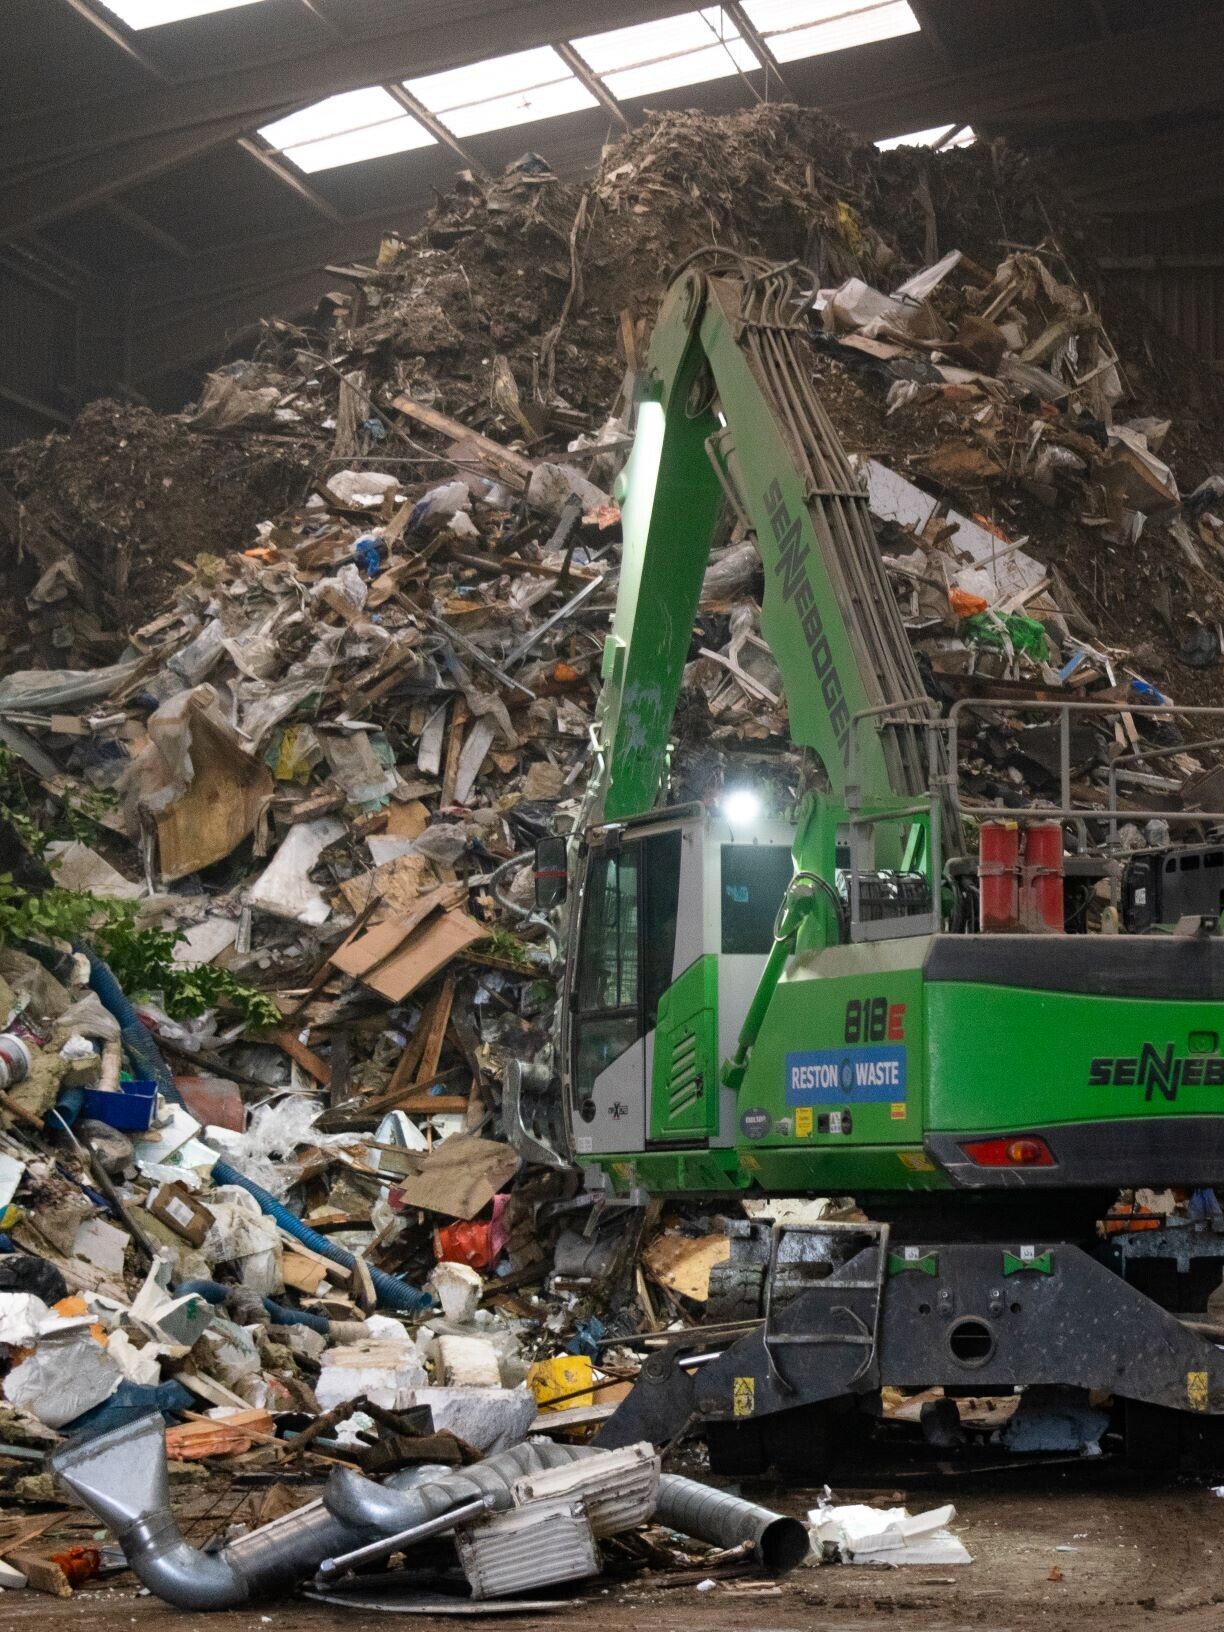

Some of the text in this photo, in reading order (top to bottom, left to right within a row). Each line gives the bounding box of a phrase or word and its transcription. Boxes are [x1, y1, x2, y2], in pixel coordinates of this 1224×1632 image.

[844, 997, 907, 1044] 818E
[791, 1061, 899, 1089] RESTON WASTE
